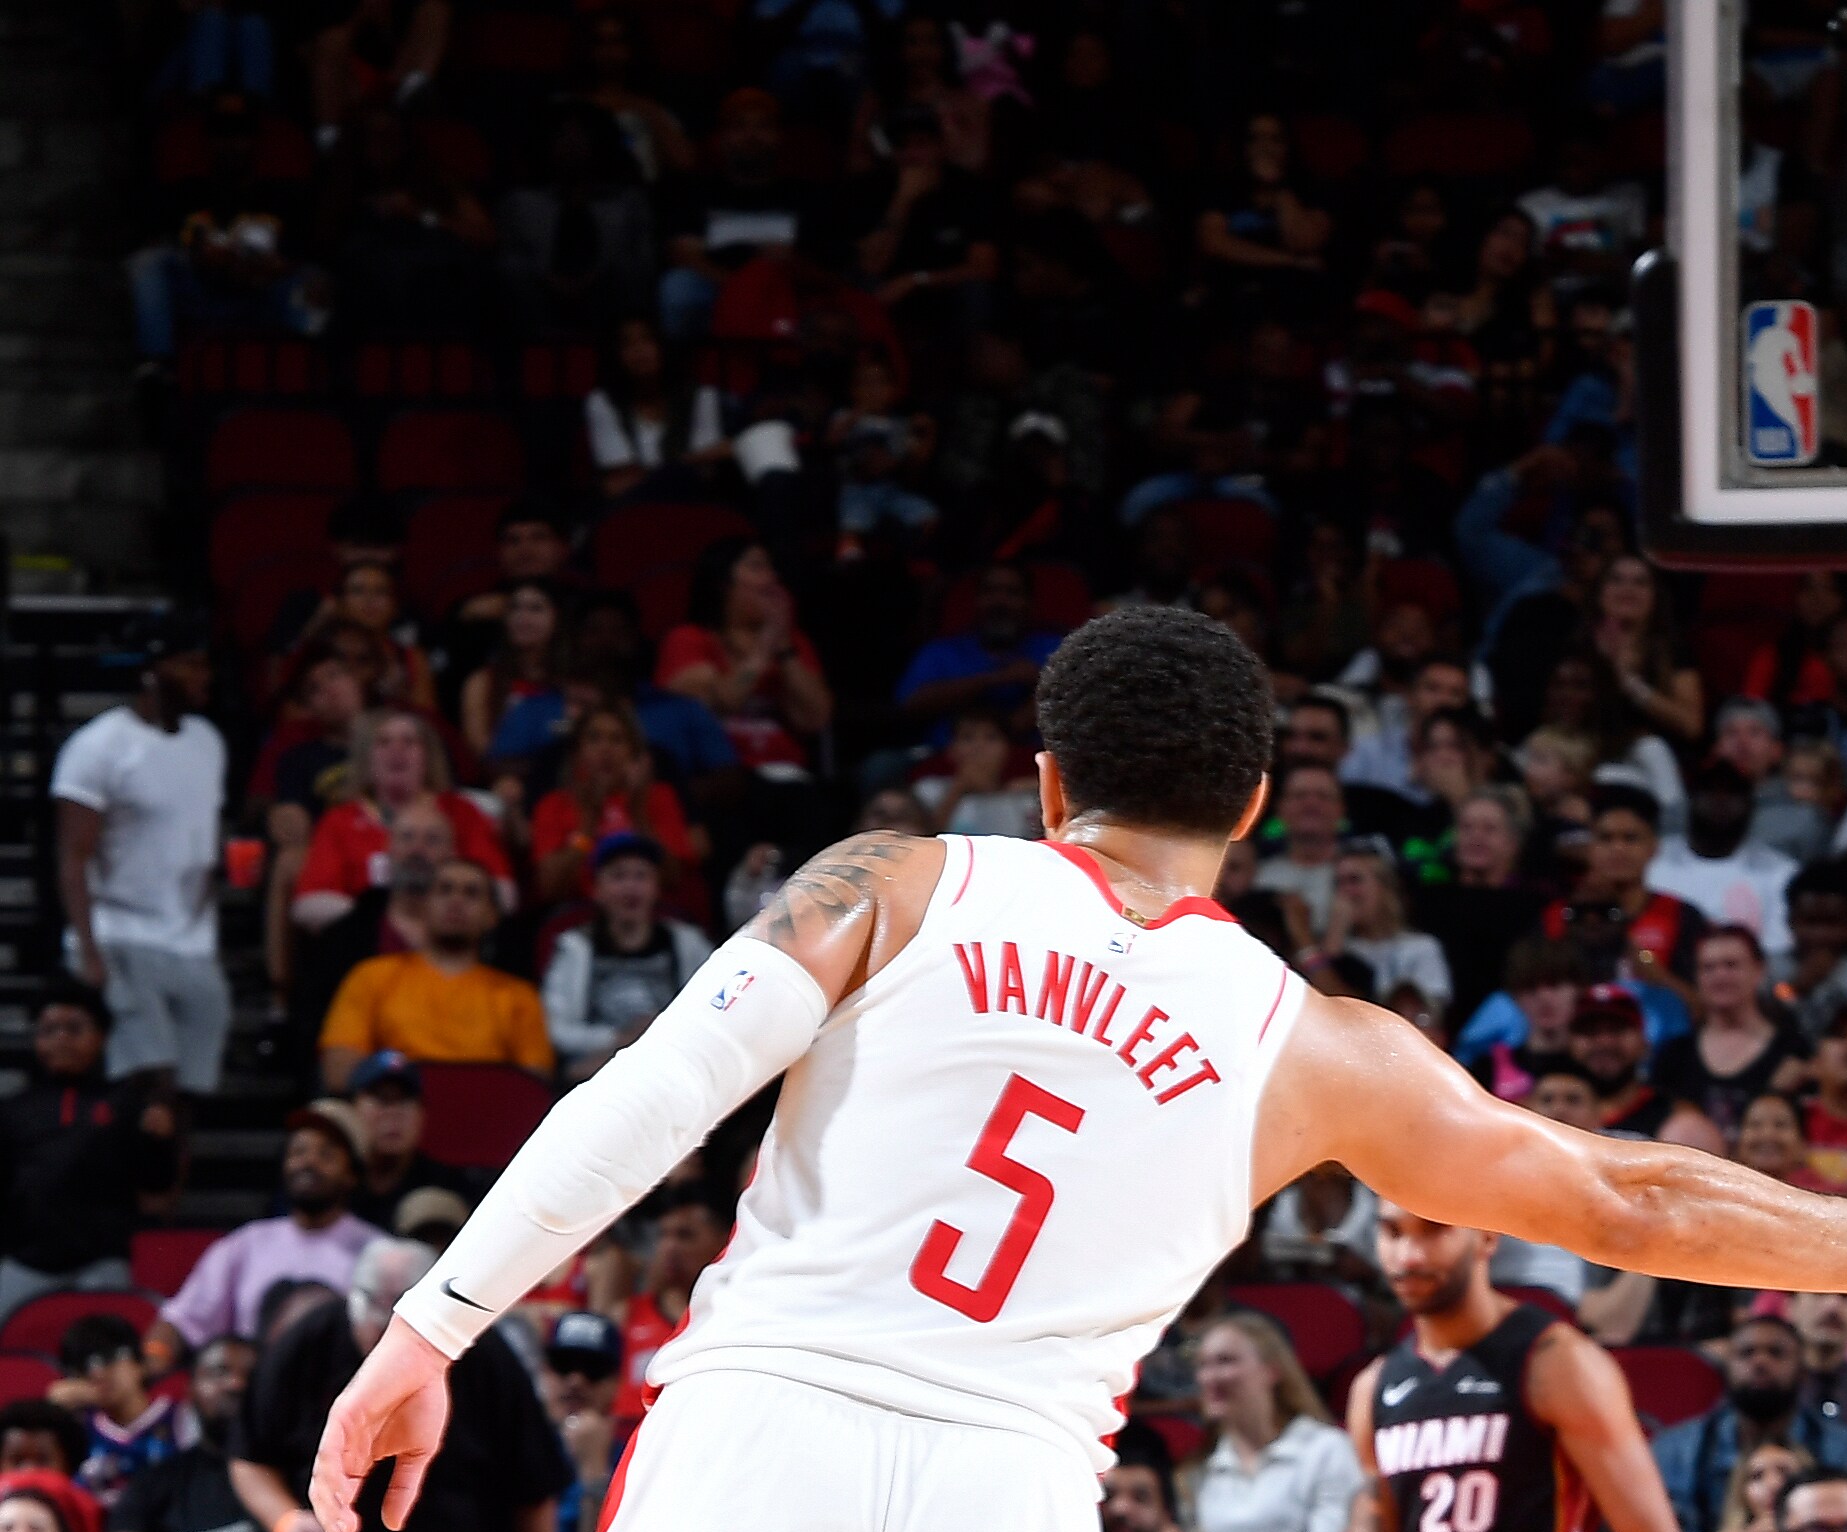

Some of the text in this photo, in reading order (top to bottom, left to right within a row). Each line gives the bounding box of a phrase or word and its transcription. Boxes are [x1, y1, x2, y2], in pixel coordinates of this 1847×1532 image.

[952, 941, 1221, 1106] VANVLEET
[908, 1071, 1086, 1323] 5
[1374, 1412, 1510, 1478] MIAMI
